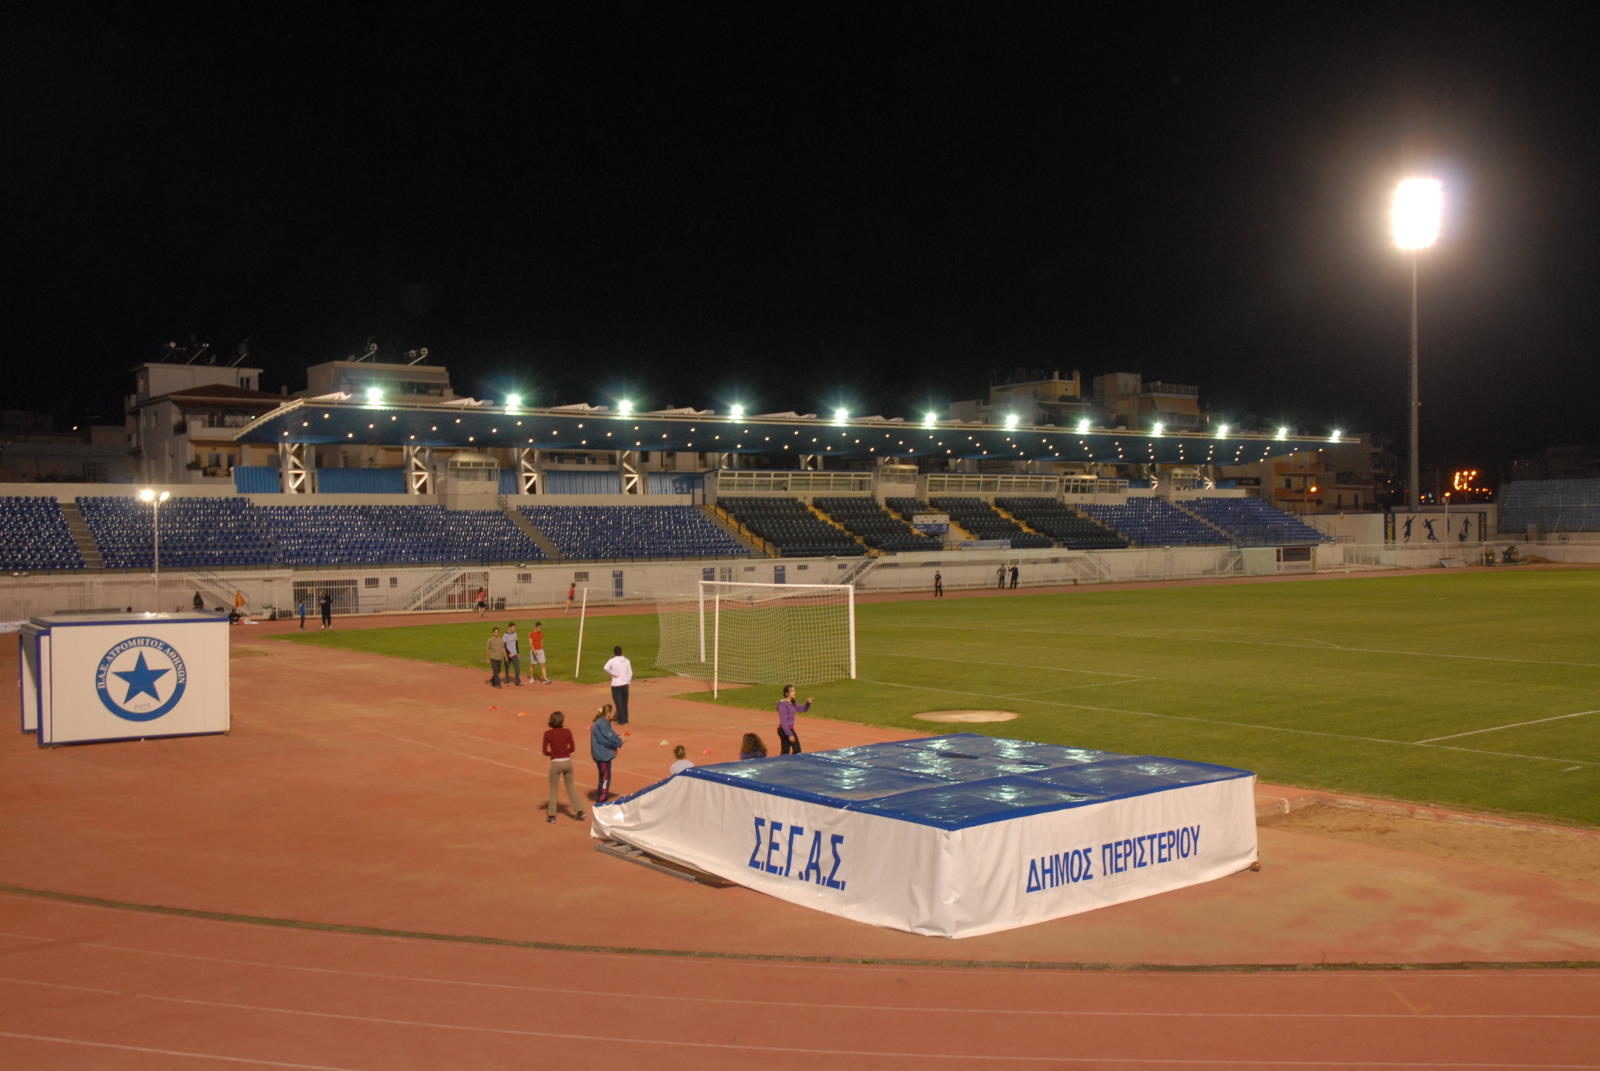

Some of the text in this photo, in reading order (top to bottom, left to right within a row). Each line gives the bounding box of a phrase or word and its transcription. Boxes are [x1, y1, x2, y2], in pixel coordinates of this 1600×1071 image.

[106, 638, 165, 662] ΑΤΡΟΜΗΤΟΣ
[1026, 824, 1201, 894] ΔΗΜΟΣ ΠΕΡΙΣΤΕΡΙΟΥ
